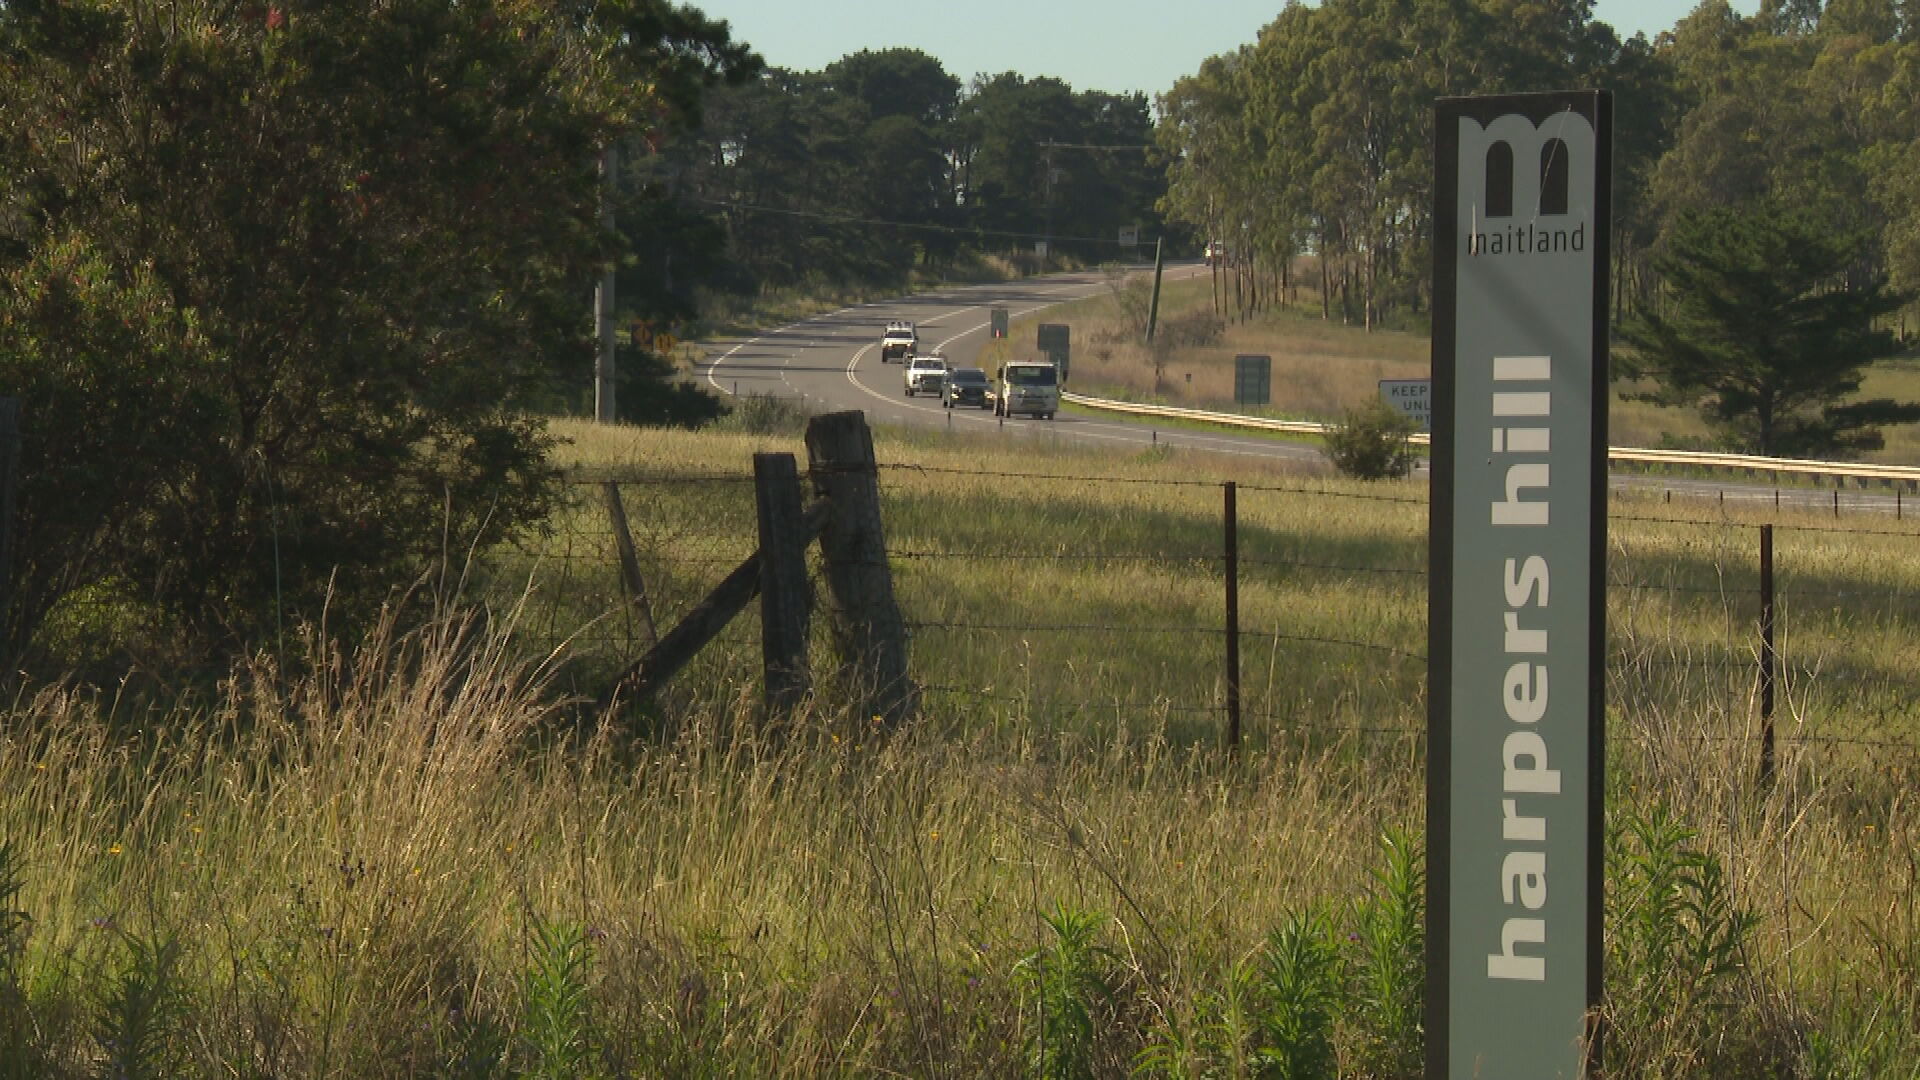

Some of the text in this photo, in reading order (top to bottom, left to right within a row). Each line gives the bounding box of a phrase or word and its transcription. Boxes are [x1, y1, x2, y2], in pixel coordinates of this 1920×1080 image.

[1467, 221, 1585, 255] maitland
[1391, 385, 1428, 397] KEEP
[1488, 356, 1560, 980] harpers hill
